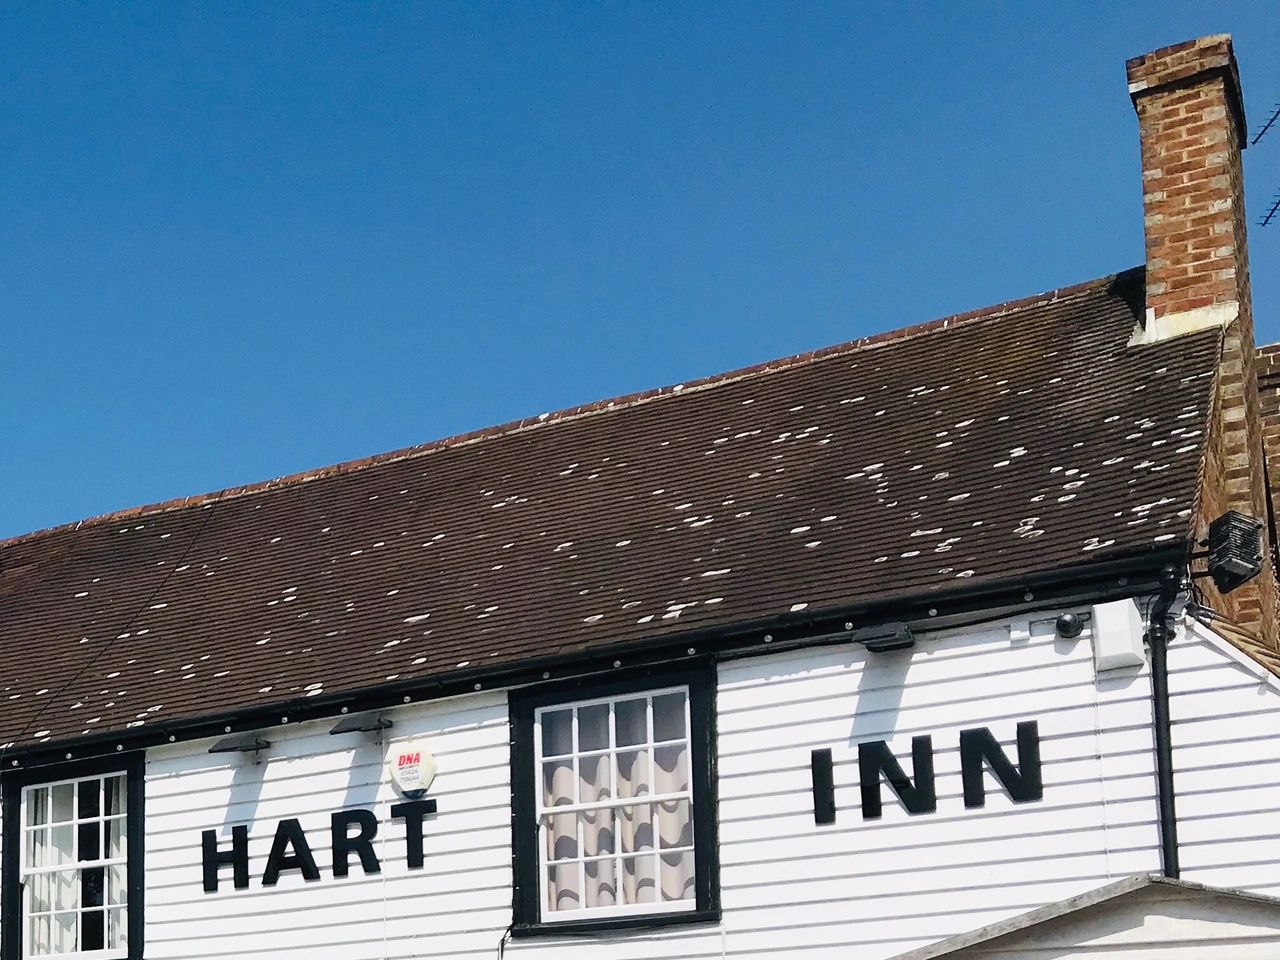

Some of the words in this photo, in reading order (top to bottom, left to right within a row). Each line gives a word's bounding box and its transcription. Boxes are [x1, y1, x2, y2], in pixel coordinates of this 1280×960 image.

[398, 752, 420, 766] DNA
[201, 798, 437, 892] HART
[811, 722, 1045, 825] INN
